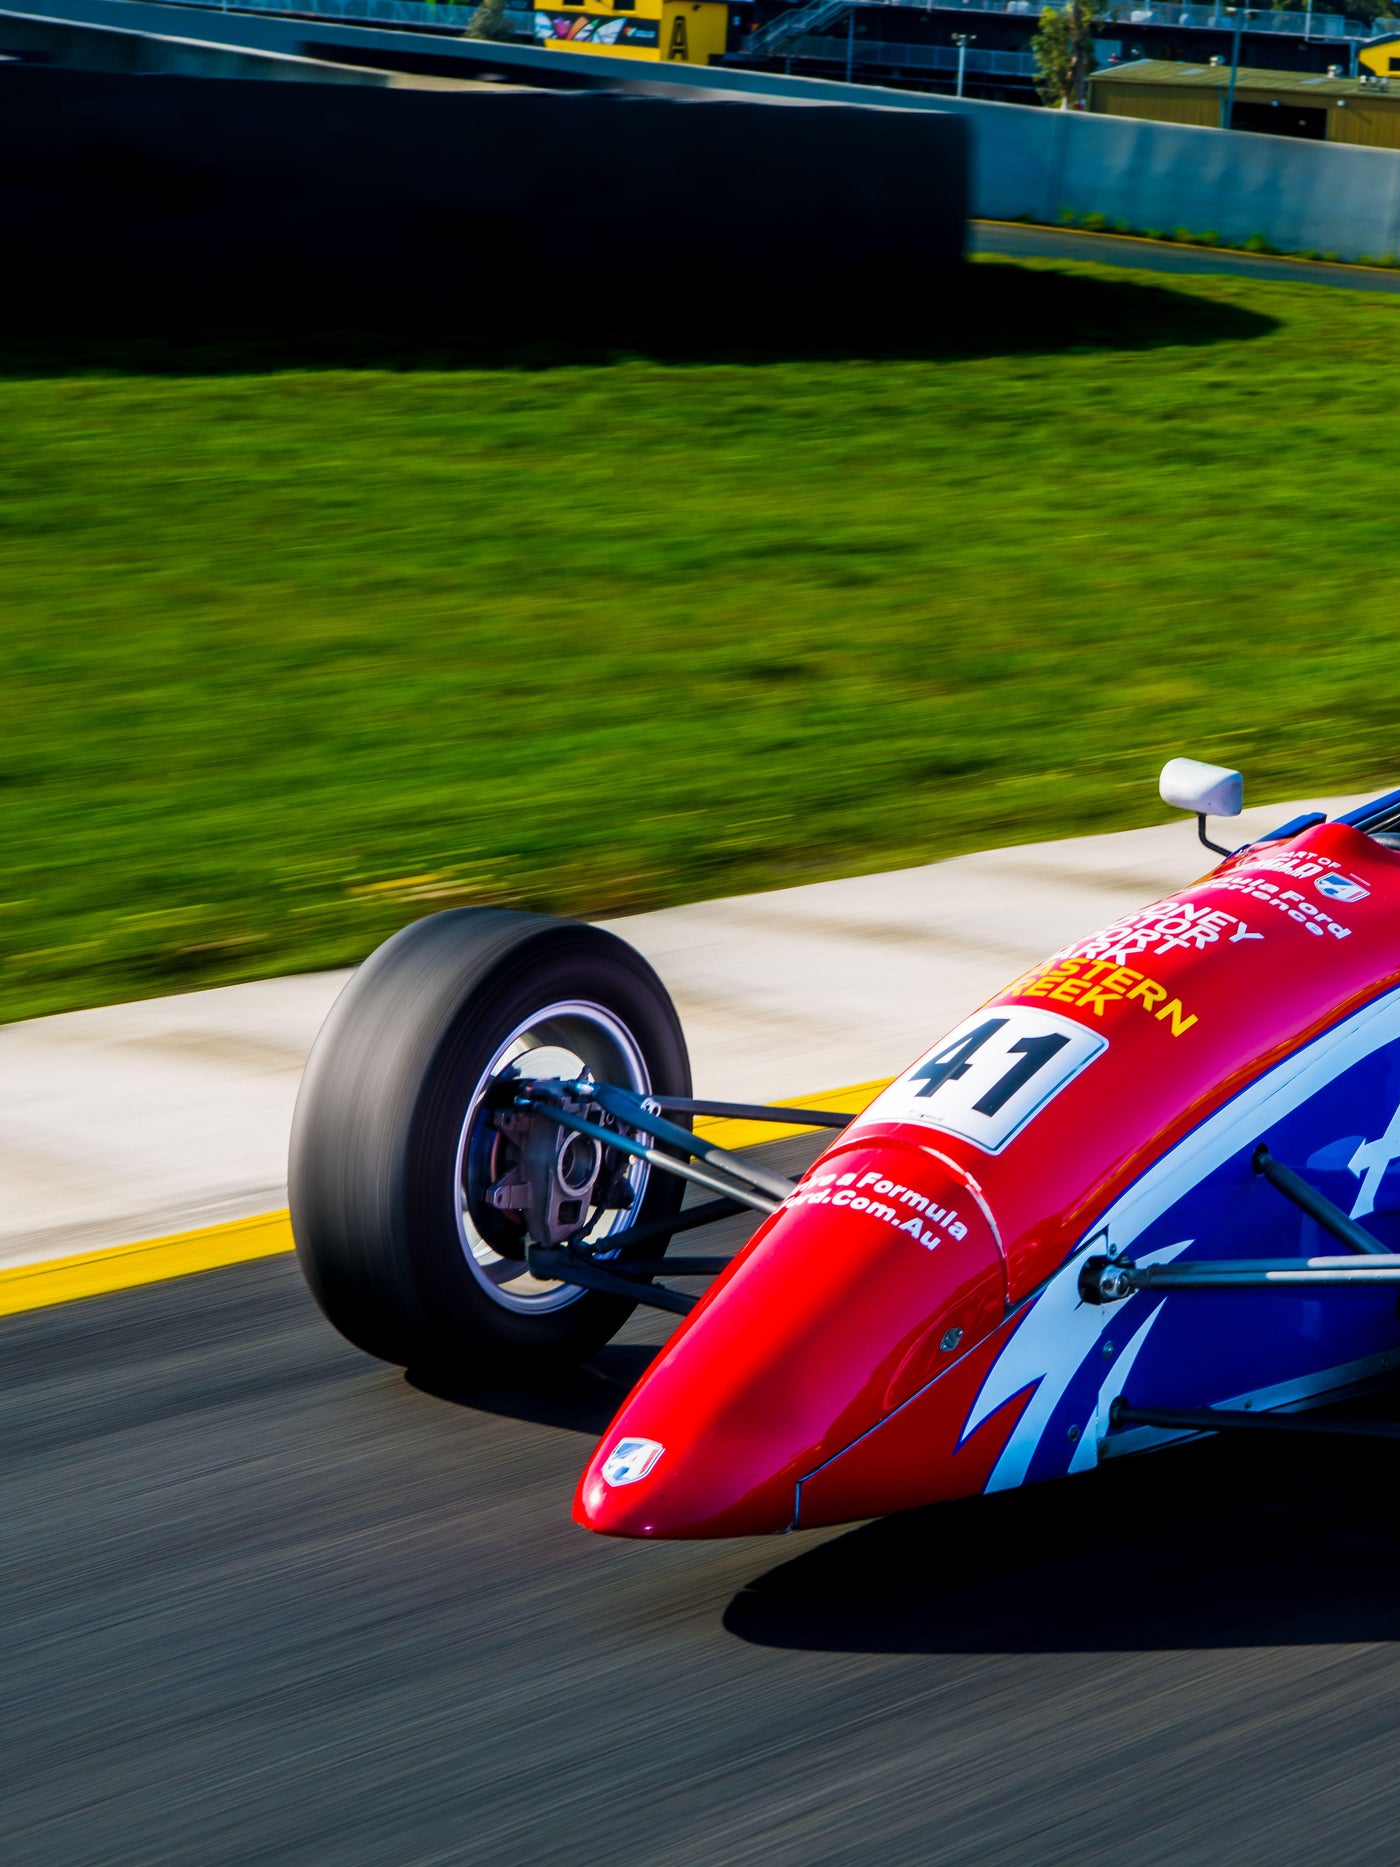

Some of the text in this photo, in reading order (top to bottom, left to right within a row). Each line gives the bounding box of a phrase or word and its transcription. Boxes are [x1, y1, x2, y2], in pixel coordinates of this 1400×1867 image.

[1279, 890, 1352, 939] Ford
[908, 1018, 1071, 1118] 41
[856, 1172, 968, 1241] Formula
